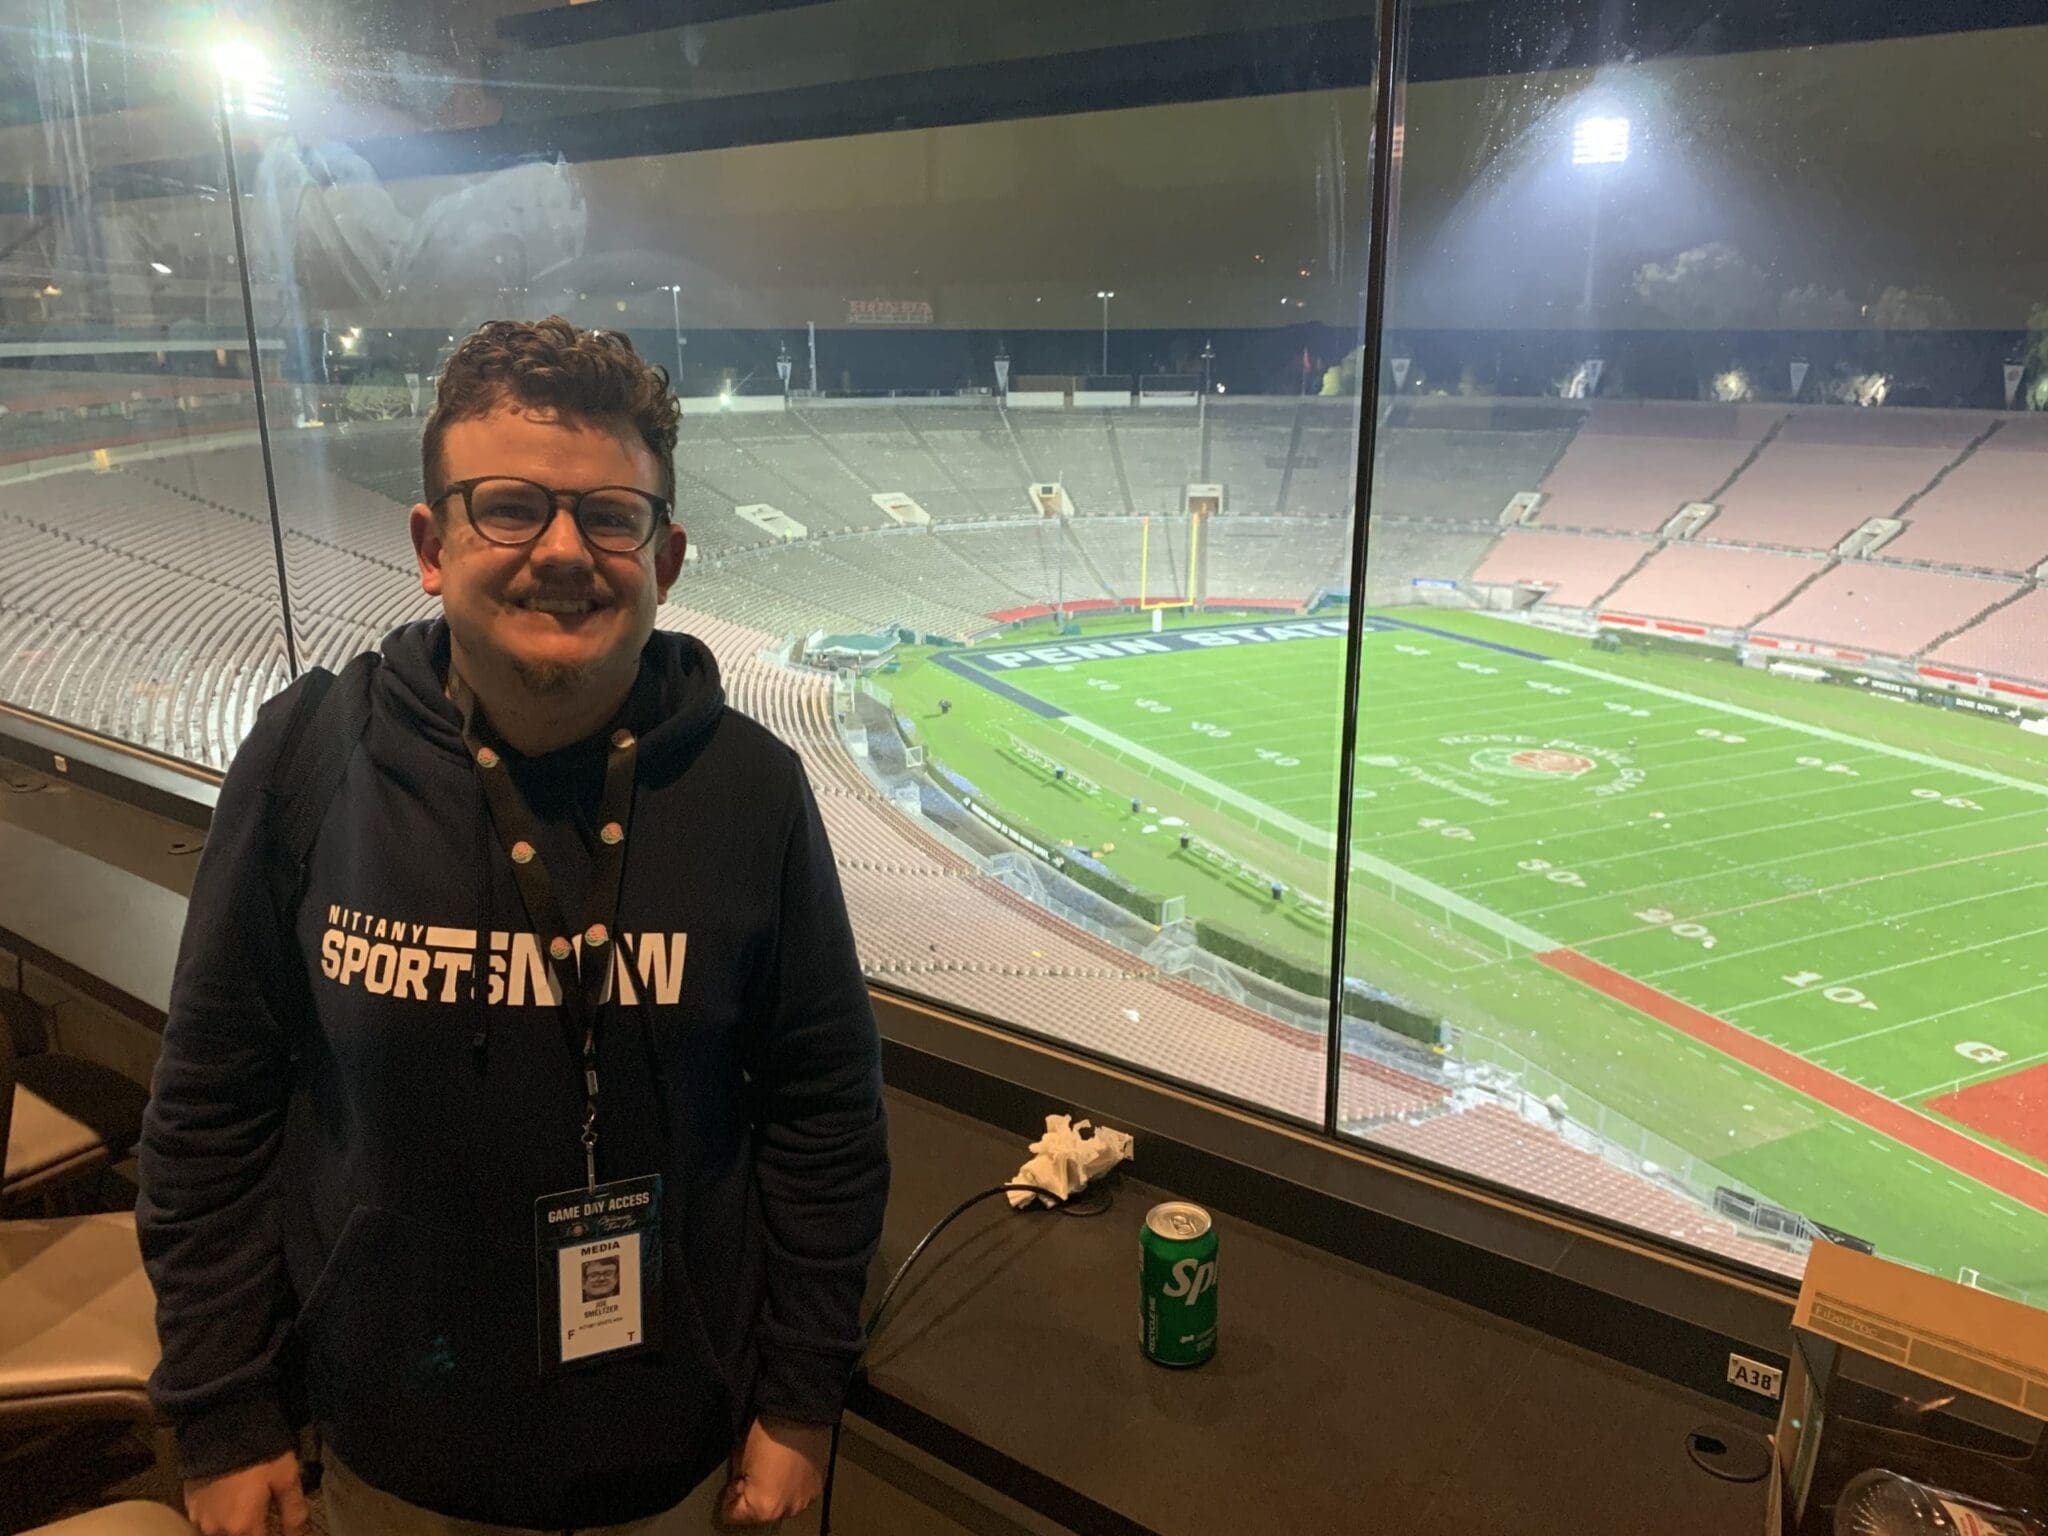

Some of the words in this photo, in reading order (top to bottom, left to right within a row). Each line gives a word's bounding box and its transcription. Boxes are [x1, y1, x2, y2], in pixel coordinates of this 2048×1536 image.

[986, 638, 1172, 668] PENN
[1517, 858, 1580, 883] 30
[328, 904, 424, 944] NITTANY
[1635, 908, 1708, 938] 20
[1781, 970, 1866, 1004] 10
[1954, 1041, 2009, 1064] G
[548, 1205, 580, 1223] GAME
[584, 1201, 605, 1216] DAY
[609, 1192, 650, 1211] ACCESS
[581, 1241, 620, 1256] MEDIA
[568, 1329, 575, 1340] F
[627, 1331, 635, 1341] T
[1735, 1366, 1772, 1391] A38
